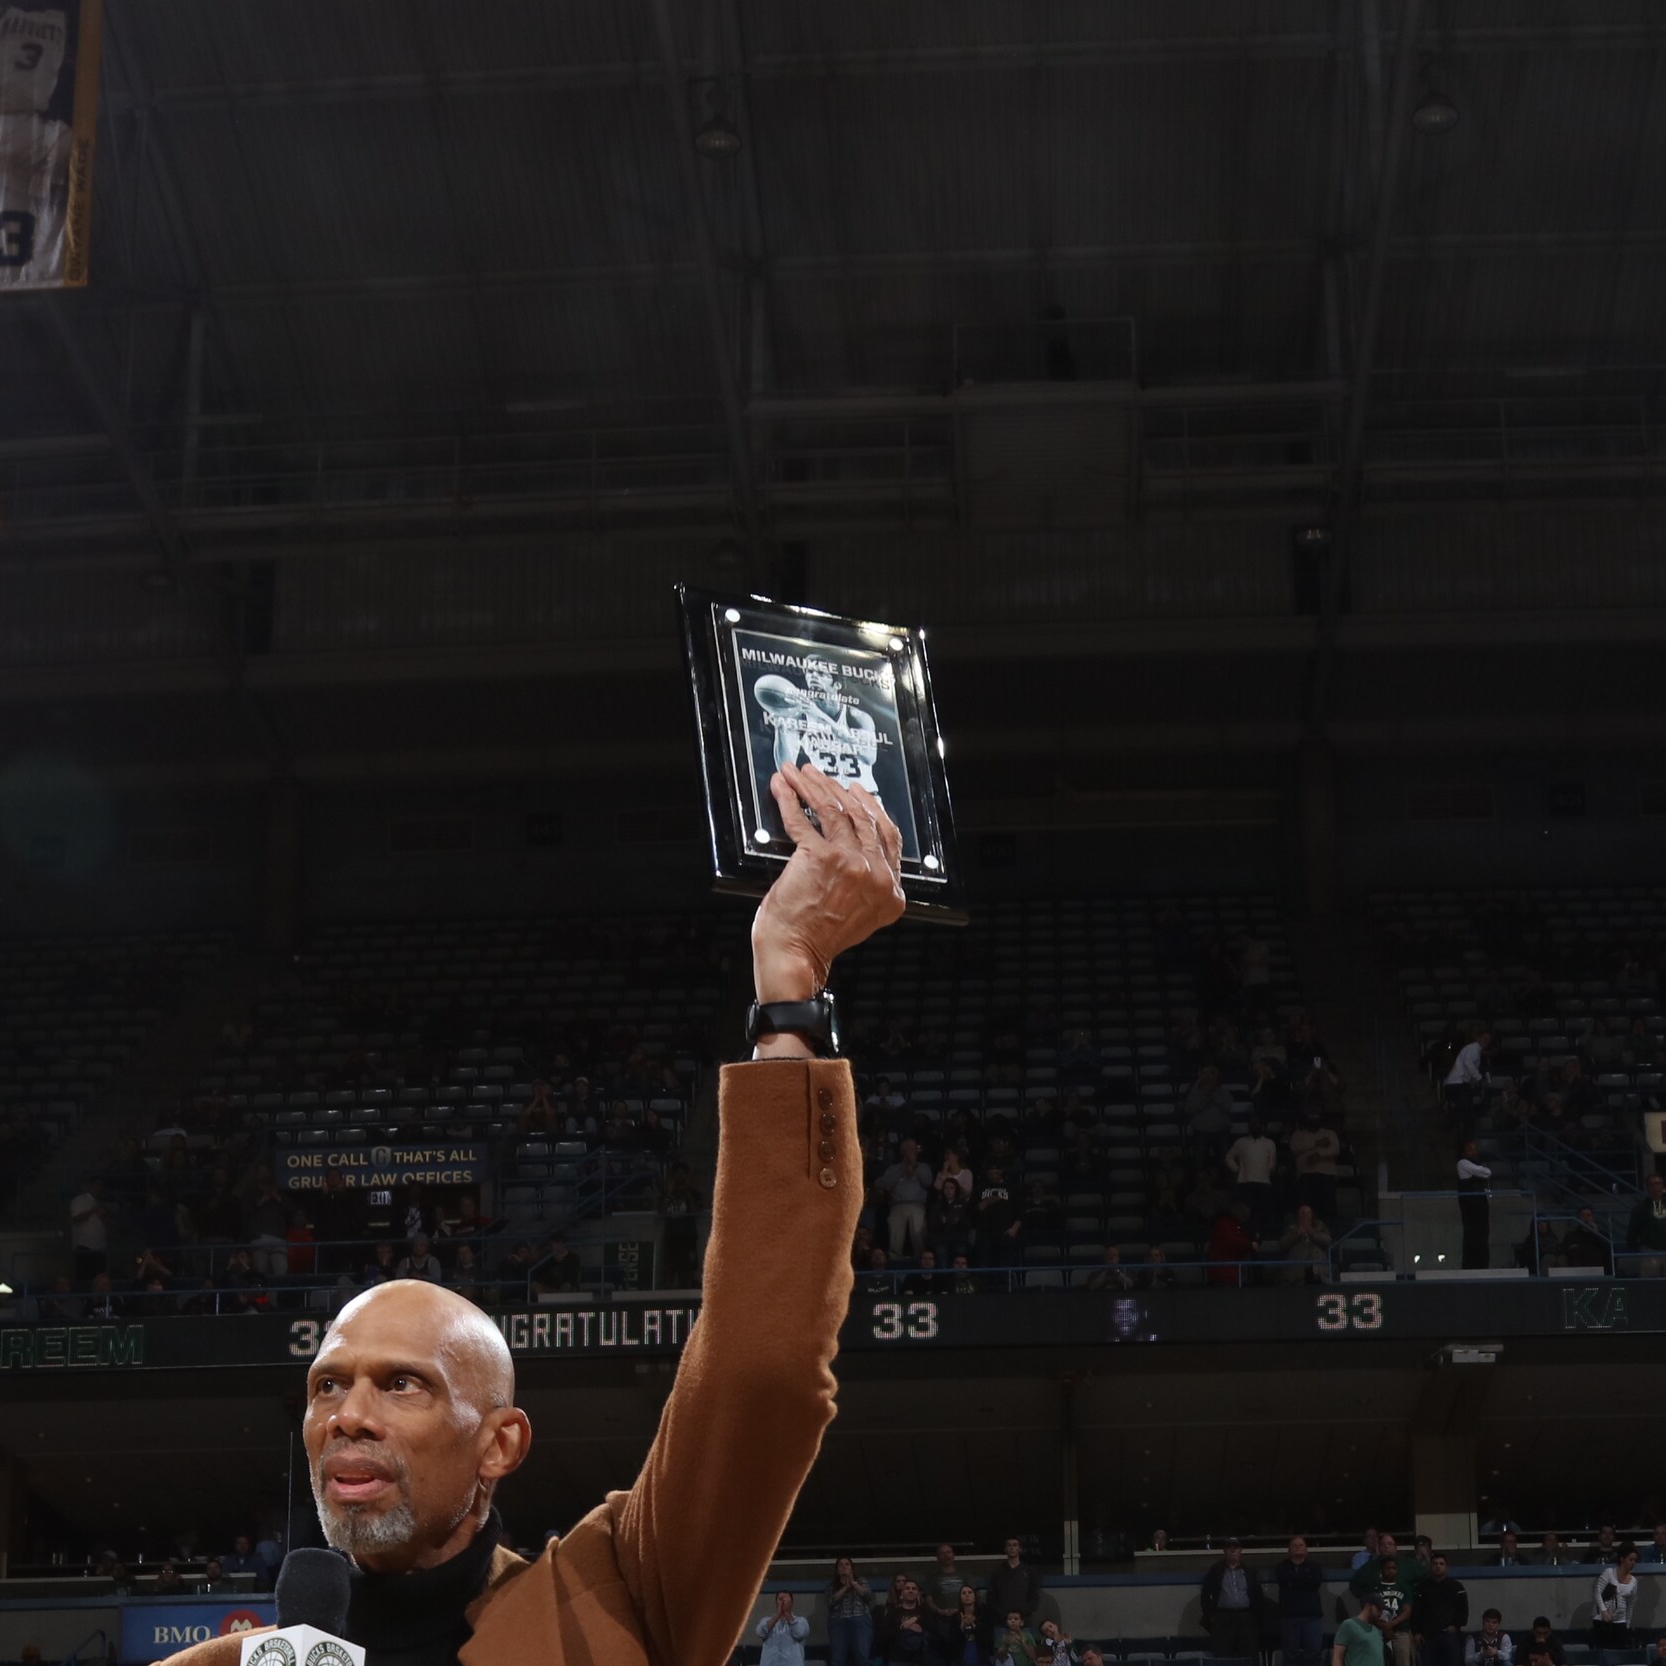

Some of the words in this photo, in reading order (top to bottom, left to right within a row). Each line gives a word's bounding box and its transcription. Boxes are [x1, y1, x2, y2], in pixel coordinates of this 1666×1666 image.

[741, 648, 838, 673] MILWAUKEE
[286, 1155, 323, 1169] ONE
[326, 1153, 368, 1168] CALL
[392, 1149, 443, 1164] THAT'S
[447, 1148, 478, 1163] ALL
[362, 1170, 400, 1186] LAW
[404, 1167, 474, 1185] OFFICES
[871, 1302, 939, 1340] 33
[1314, 1293, 1382, 1331] 33
[154, 1625, 212, 1644] BMO
